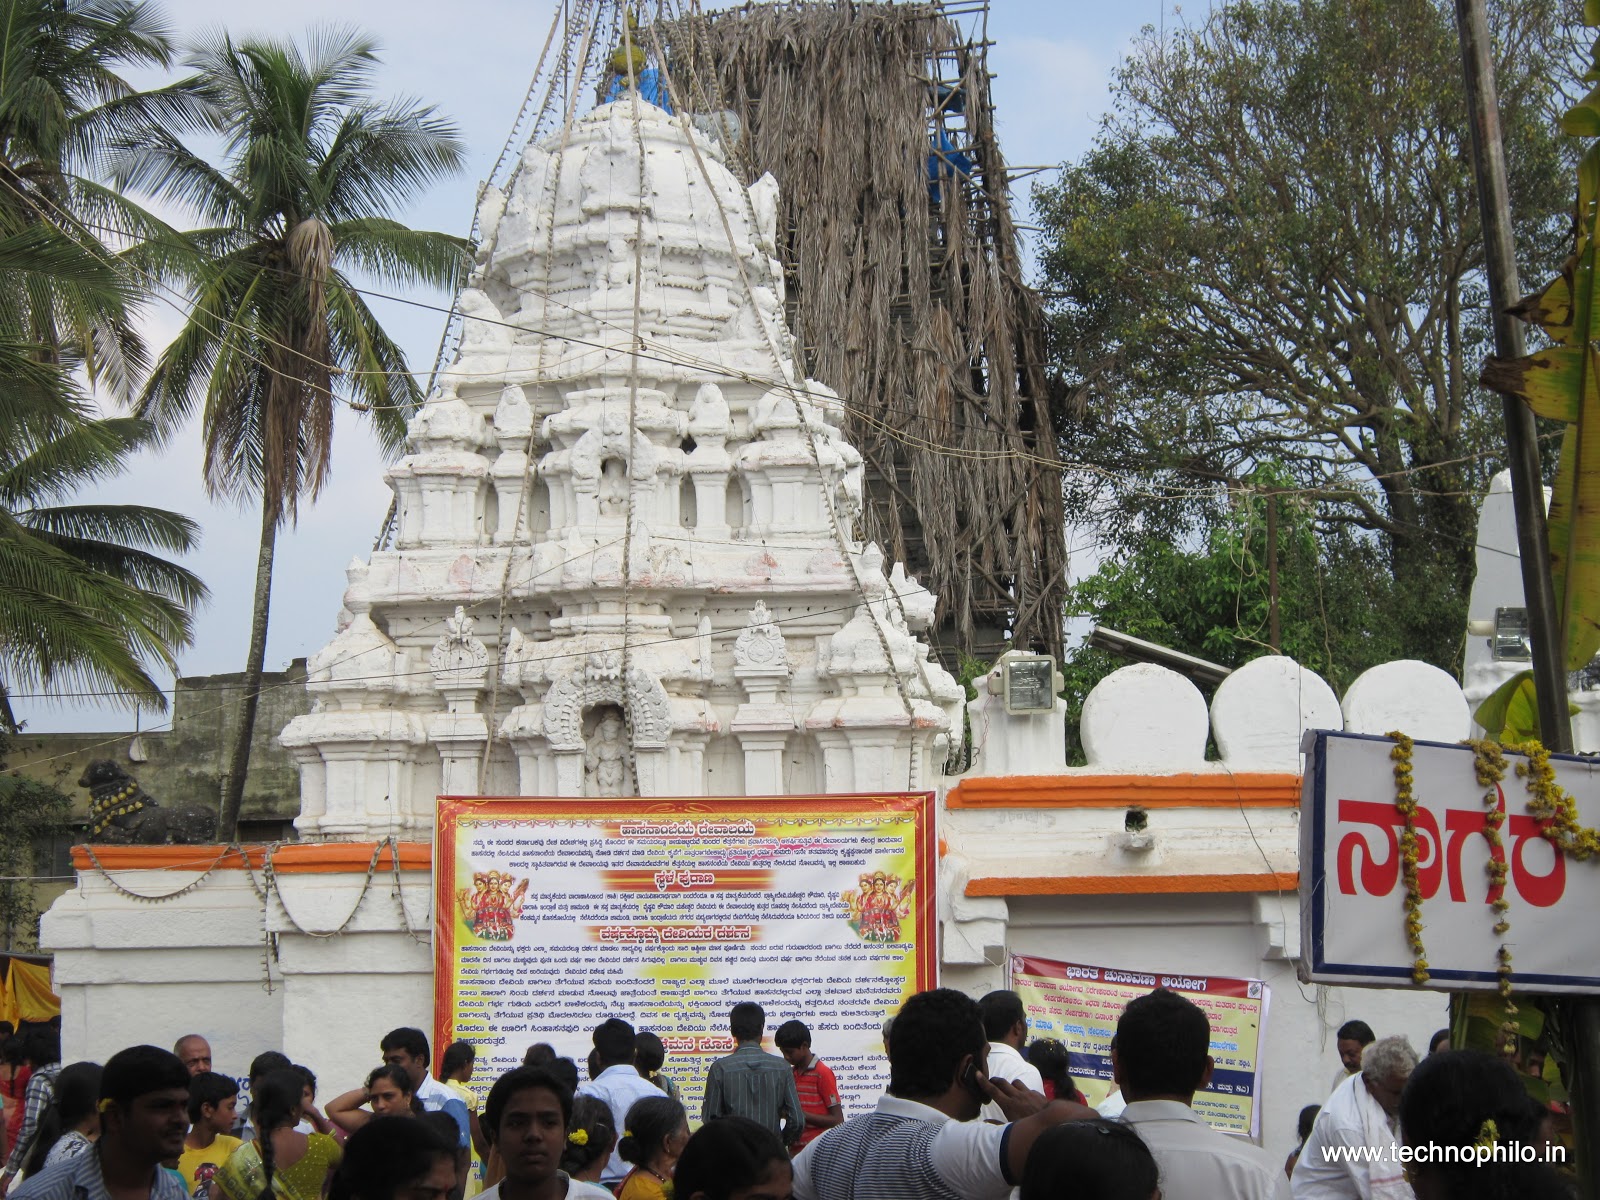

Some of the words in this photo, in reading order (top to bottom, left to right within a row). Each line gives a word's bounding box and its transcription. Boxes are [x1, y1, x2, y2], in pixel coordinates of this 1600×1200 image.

[622, 824, 693, 835] ಹಾಸನಾಂಬೆಯ
[699, 822, 754, 834] ದೇವಾಲಯ
[680, 872, 714, 886] ಪುರಾಣ
[664, 927, 712, 939] ದೇವಿಯರ
[716, 926, 750, 939] ದರ್ಶನ
[1066, 965, 1098, 980] ಭಾರತ
[1104, 968, 1156, 986] ಚುನಾವಣಾ
[1162, 974, 1207, 990] ಆಯೋಗ
[700, 1037, 733, 1050] ಸೊಸೆ
